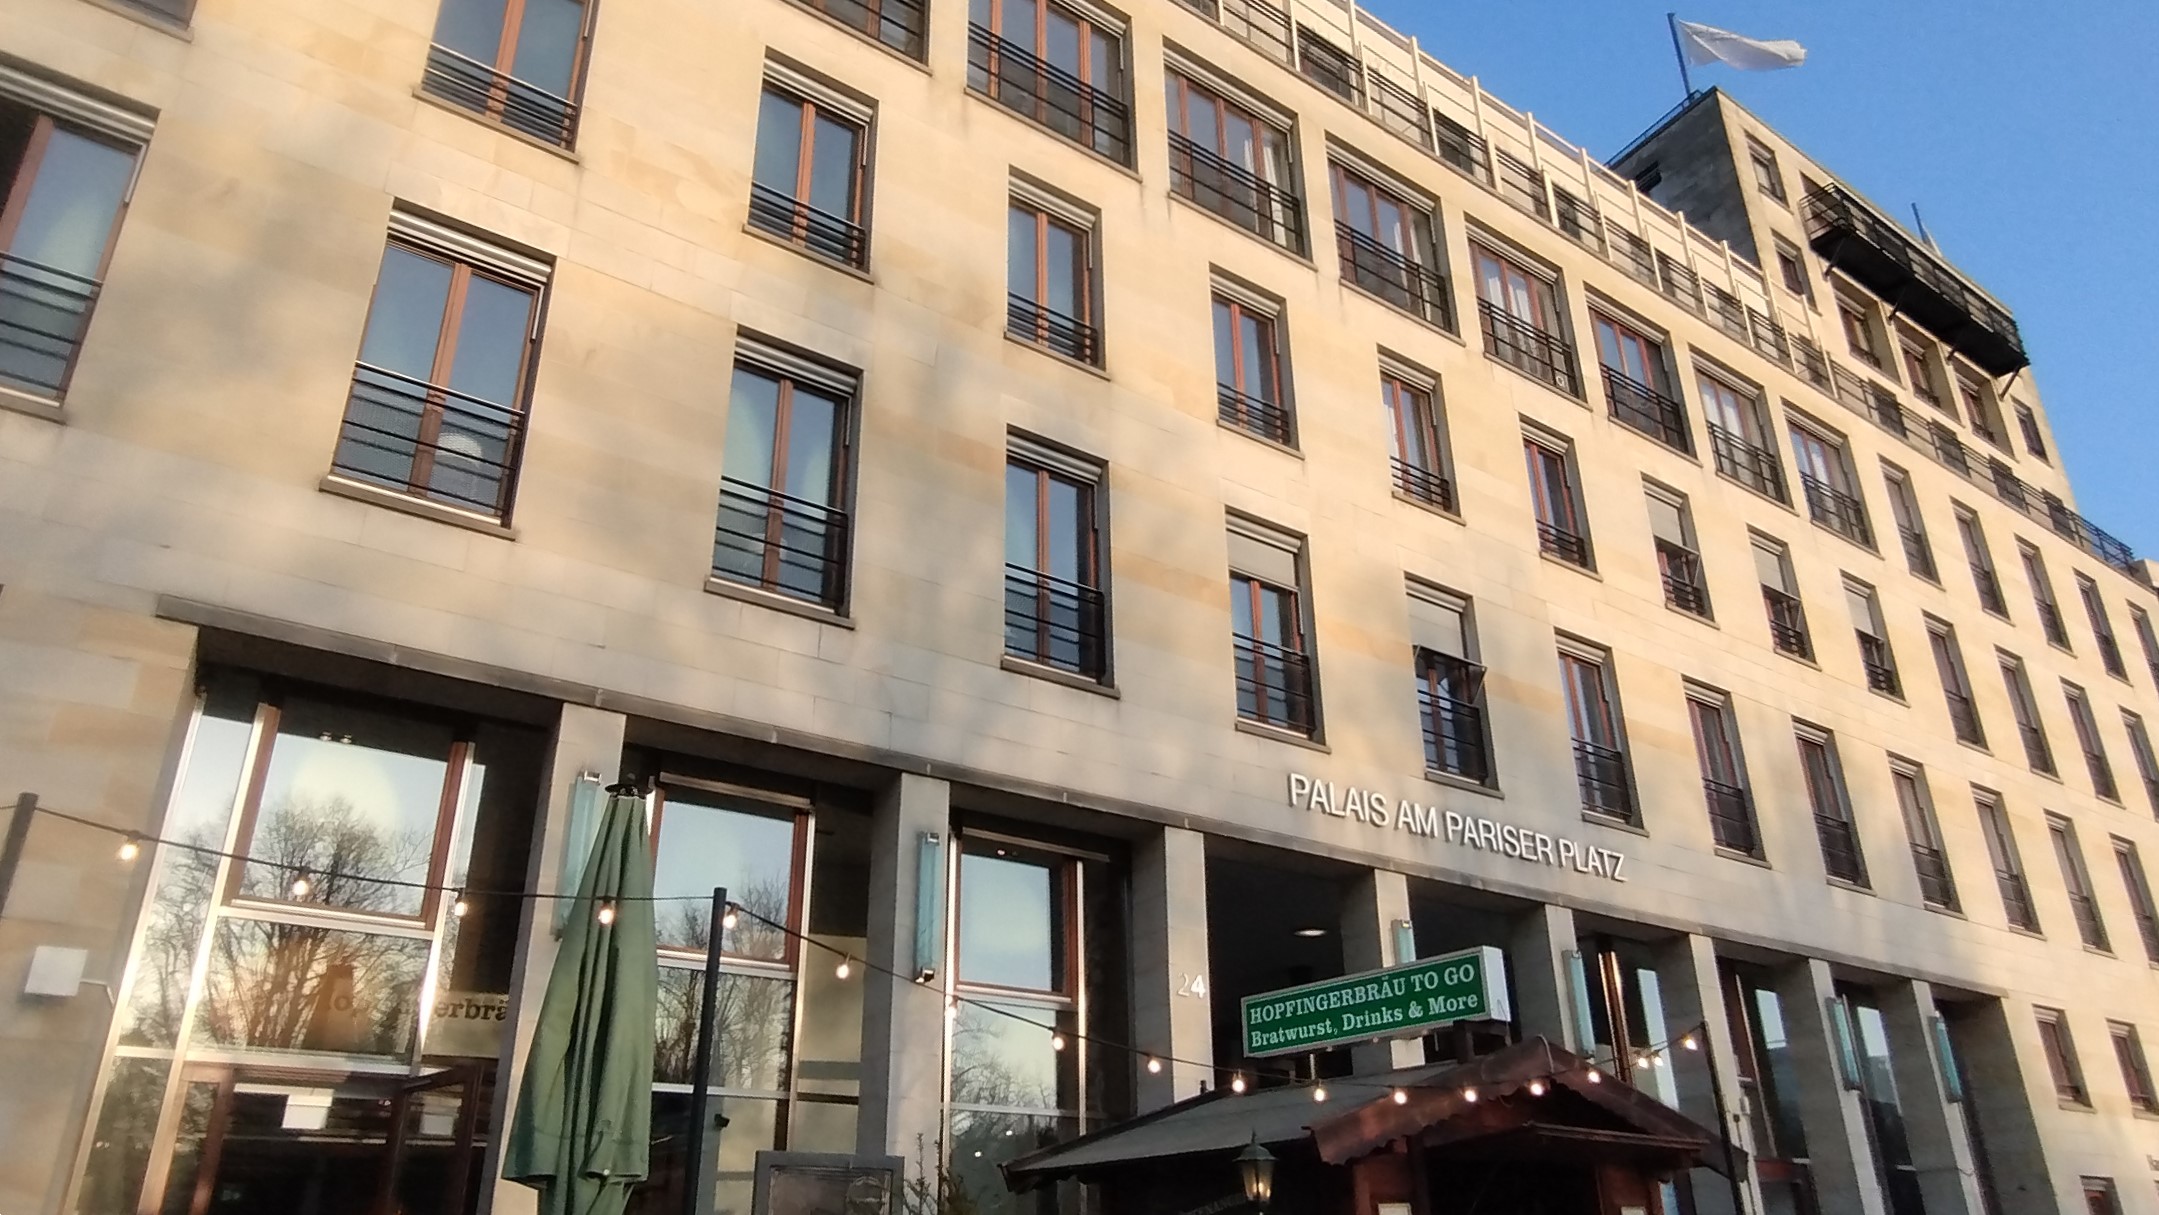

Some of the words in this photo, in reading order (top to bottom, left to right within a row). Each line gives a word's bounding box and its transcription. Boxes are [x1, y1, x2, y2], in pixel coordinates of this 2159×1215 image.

[1288, 772, 1390, 827] PALAIS
[1396, 799, 1439, 838] AM
[1444, 810, 1554, 867] PARISER
[1558, 838, 1629, 883] PLATZ
[1177, 972, 1206, 999] 24
[1249, 977, 1406, 1025] HOPFINGERBRÄU
[1411, 971, 1439, 993] TO
[1443, 963, 1475, 987] GO
[1250, 1020, 1338, 1049] Bratwurst,
[1342, 1006, 1403, 1032] Drinks
[1408, 1001, 1423, 1018] &
[1428, 993, 1478, 1017] More
